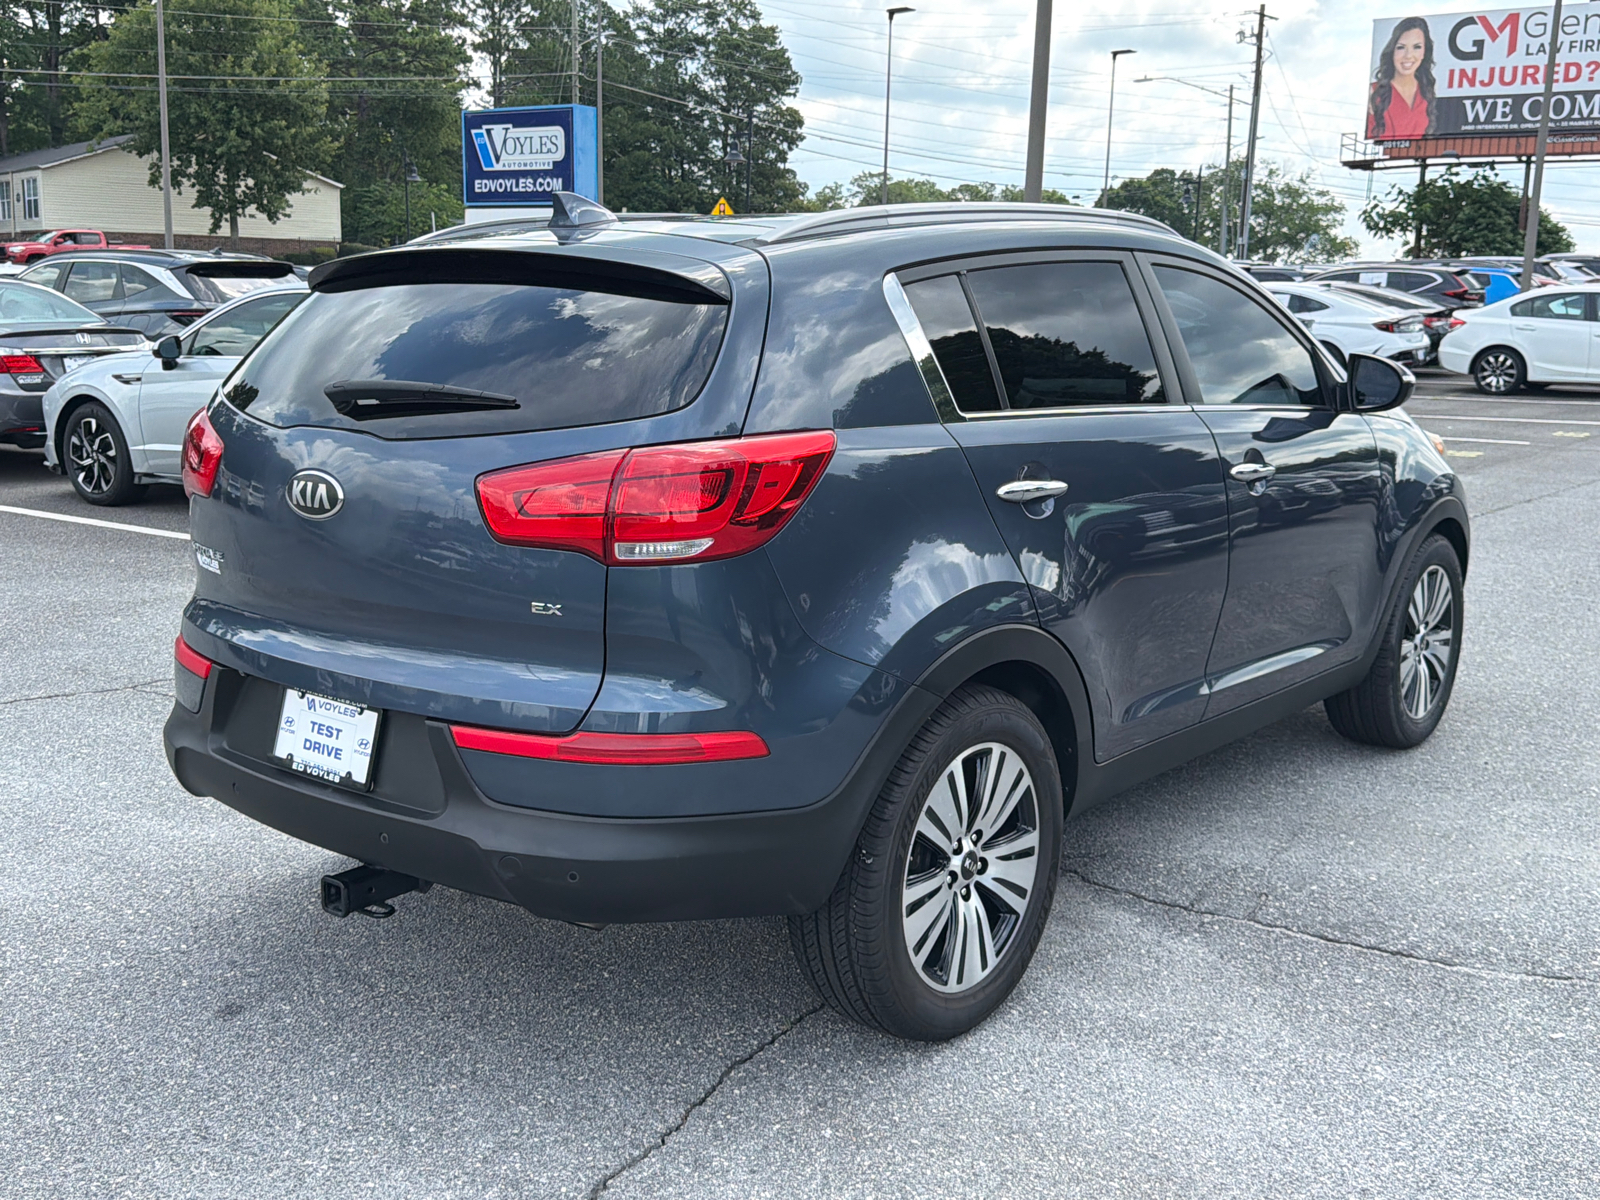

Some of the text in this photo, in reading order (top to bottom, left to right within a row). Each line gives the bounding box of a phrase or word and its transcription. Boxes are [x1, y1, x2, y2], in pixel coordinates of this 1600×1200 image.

[1448, 11, 1600, 61] GM Gen
[1568, 38, 1600, 53] FIR
[1447, 60, 1600, 89] INJURED?
[1462, 98, 1513, 123] WE
[485, 127, 559, 165] VOYLES
[502, 161, 551, 169] AUTOMOTIVE
[474, 177, 563, 193] EDVOYLES.COM
[291, 479, 331, 510] KIA
[531, 601, 563, 616] EX
[318, 699, 357, 719] VOYLES
[310, 720, 343, 740] TEST
[302, 737, 343, 761] DRIVE
[292, 761, 304, 771] ED
[306, 765, 340, 783] VOYLES
